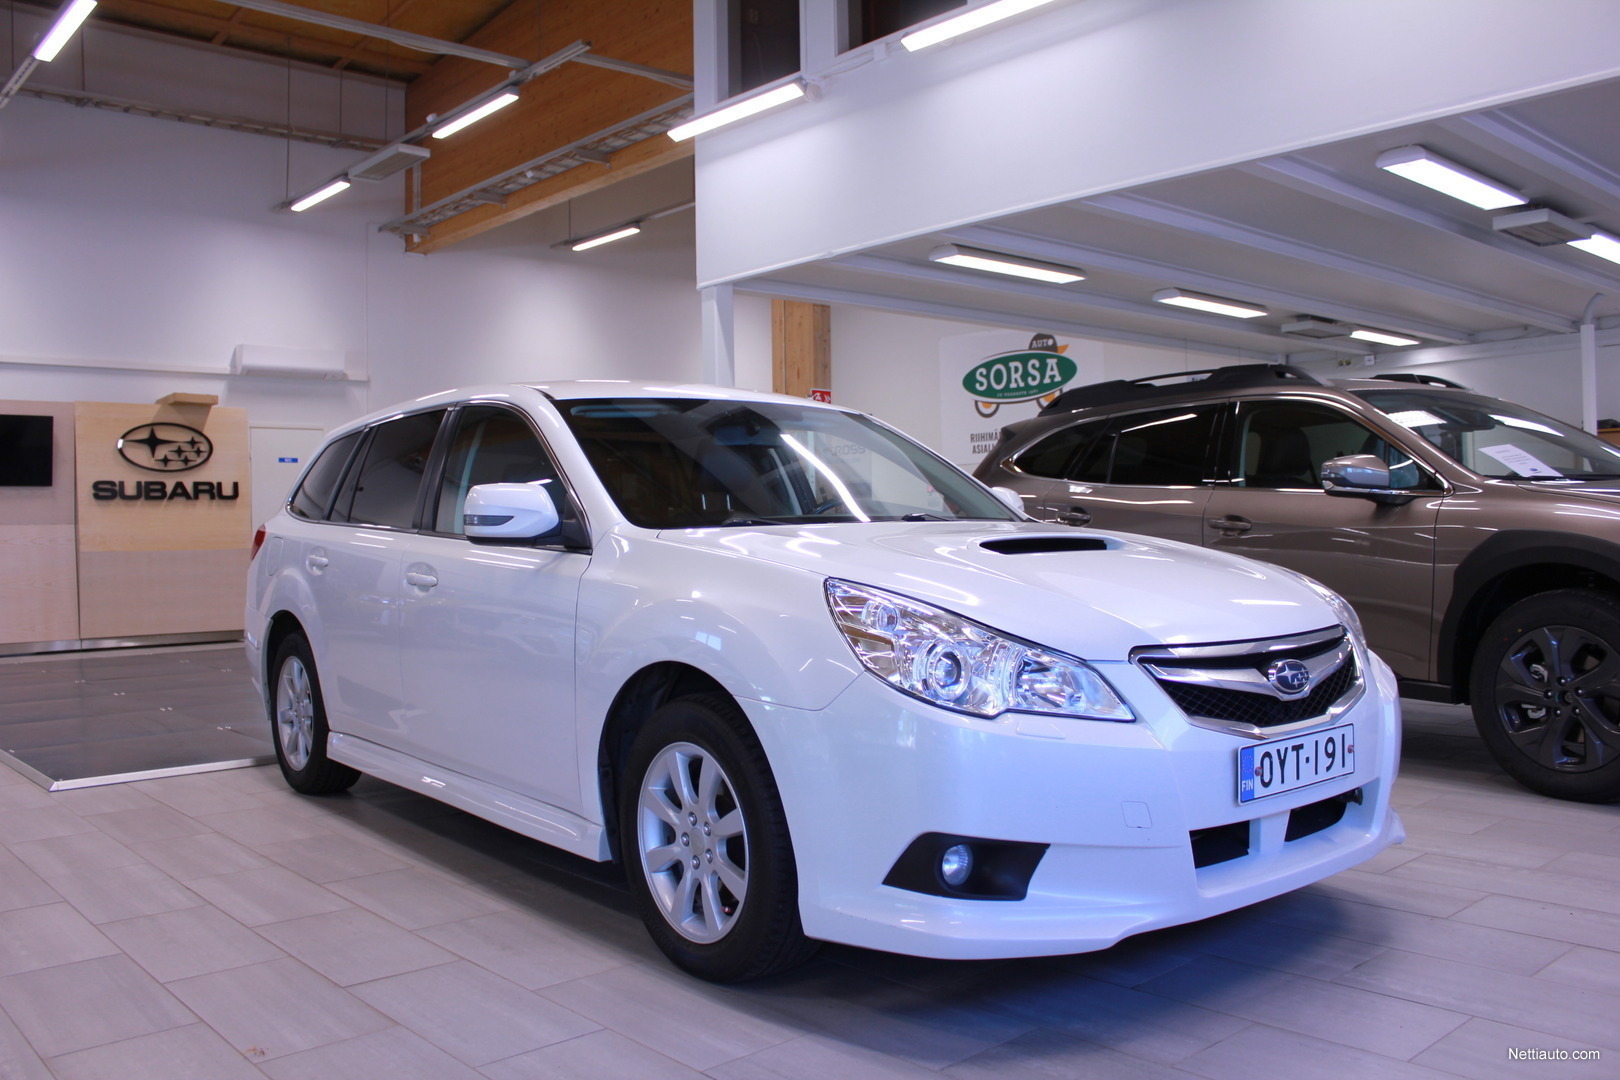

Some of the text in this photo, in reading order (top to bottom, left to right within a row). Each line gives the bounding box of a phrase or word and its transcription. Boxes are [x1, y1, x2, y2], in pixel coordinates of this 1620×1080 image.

[1031, 338, 1054, 348] AUTO
[975, 358, 1062, 391] SORSA
[92, 480, 240, 501] SUBARU
[1259, 733, 1346, 788] OYT-191
[1241, 778, 1254, 792] FIN
